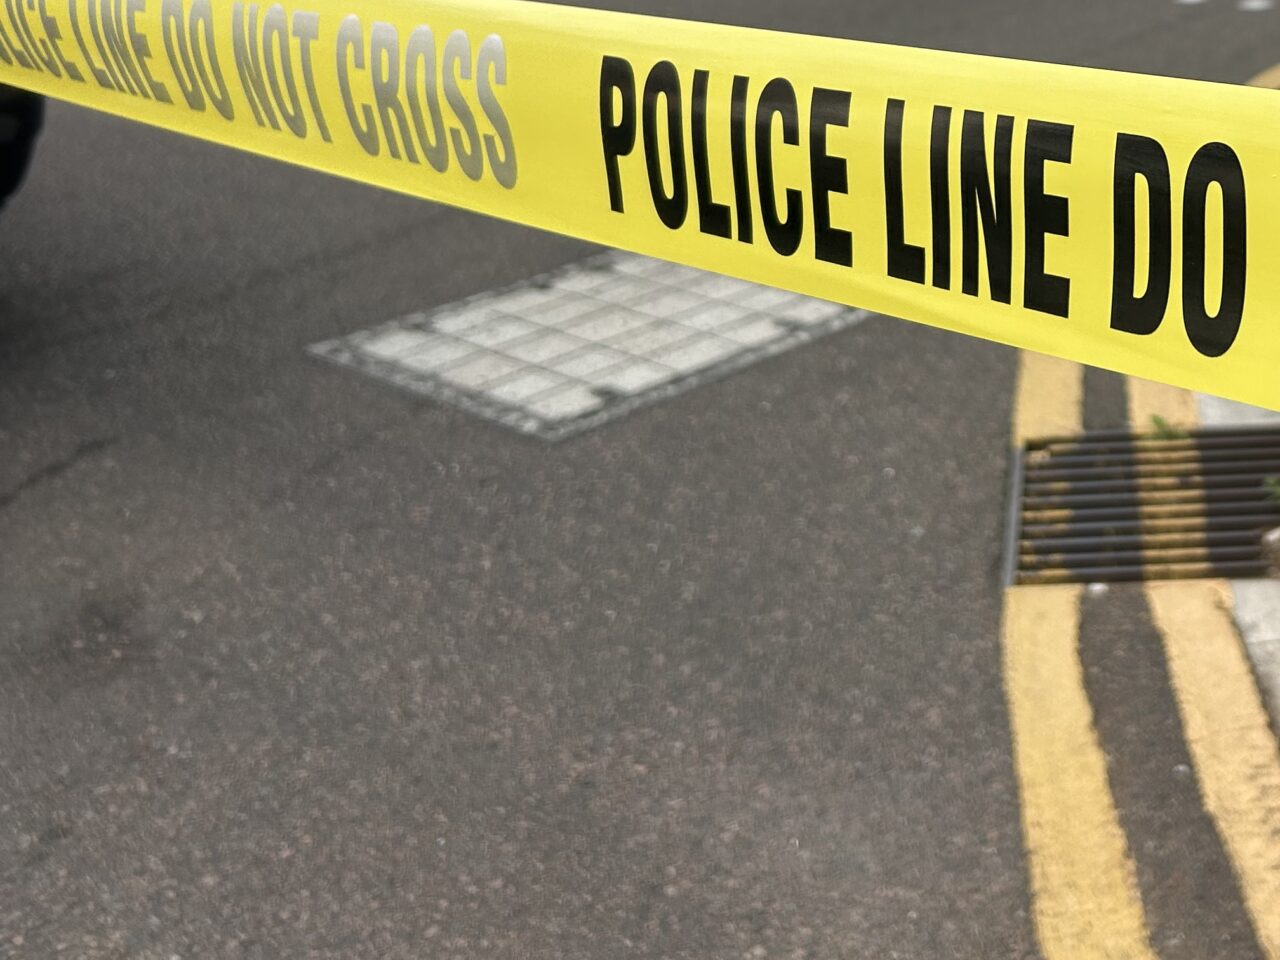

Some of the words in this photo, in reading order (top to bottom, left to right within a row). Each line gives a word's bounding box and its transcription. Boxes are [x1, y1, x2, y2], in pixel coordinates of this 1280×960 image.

[232, 1, 333, 143] NOT
[336, 13, 518, 189] CROSS
[600, 55, 853, 268] POLICE
[883, 97, 1075, 319] LINE
[1110, 131, 1247, 358] DO
